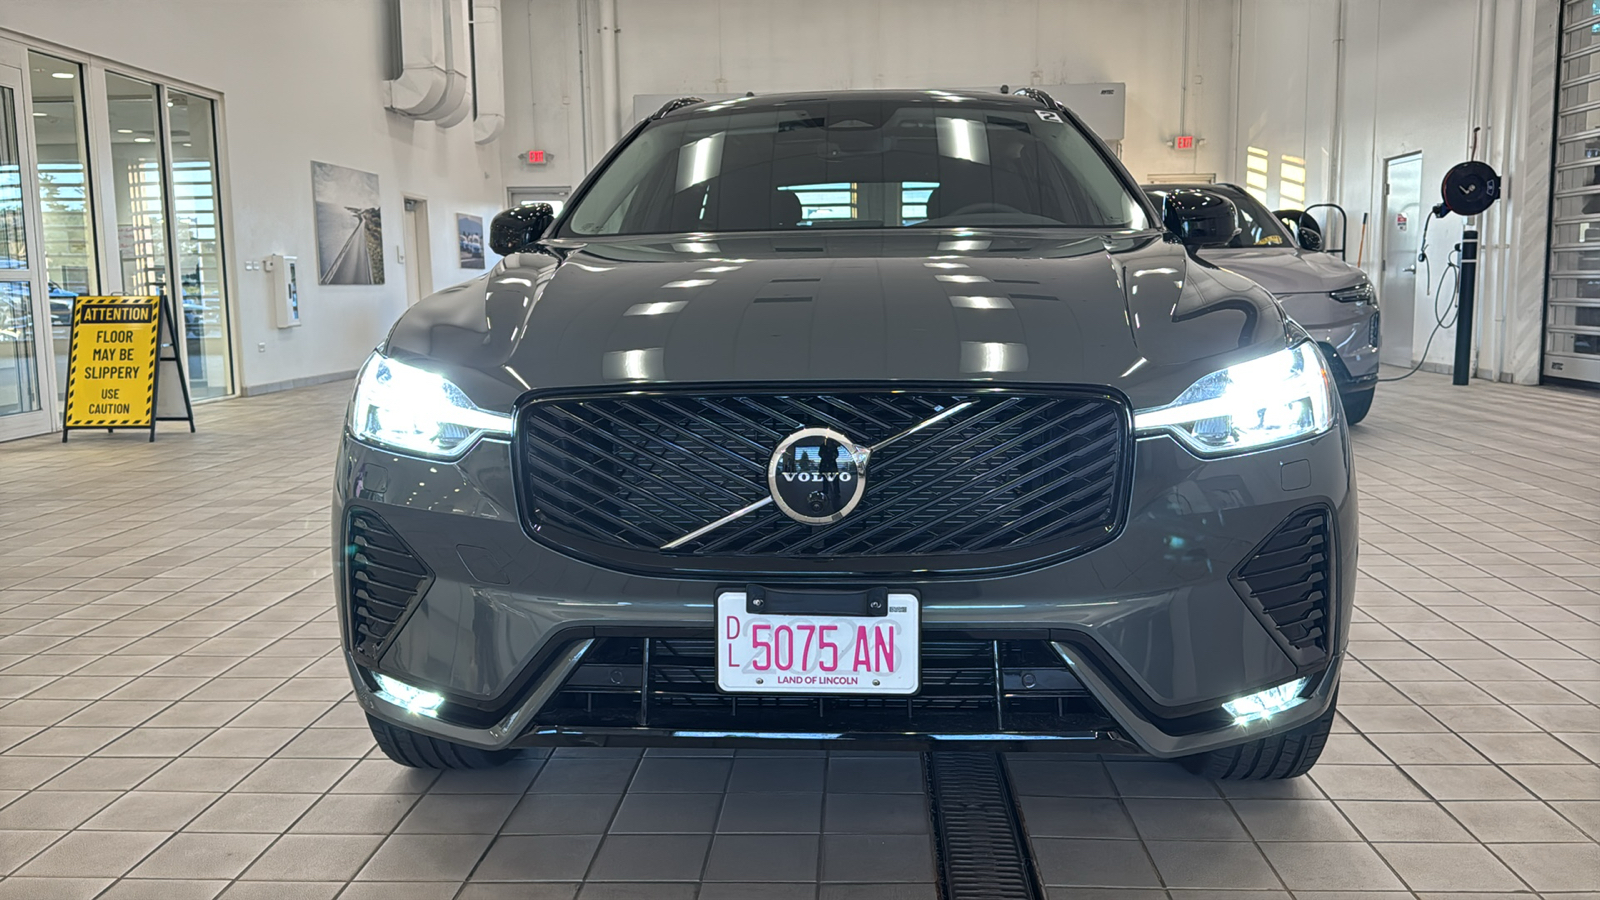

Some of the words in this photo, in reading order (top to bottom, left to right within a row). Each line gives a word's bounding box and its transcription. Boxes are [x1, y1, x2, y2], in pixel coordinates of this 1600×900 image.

[1177, 136, 1193, 149] EXIT
[83, 307, 149, 321] ATTENTION
[96, 330, 134, 343] FLOOR
[92, 348, 116, 361] MAY
[119, 348, 134, 361] BE
[84, 366, 140, 379] SLIPPERY
[101, 388, 120, 399] USE
[88, 403, 130, 414] CAUTION
[781, 472, 852, 482] VOLVO
[752, 624, 838, 672] 5075
[852, 625, 894, 673] AN
[777, 676, 803, 684] LAND
[804, 676, 817, 684] OF
[819, 676, 858, 685] LINCOLN
